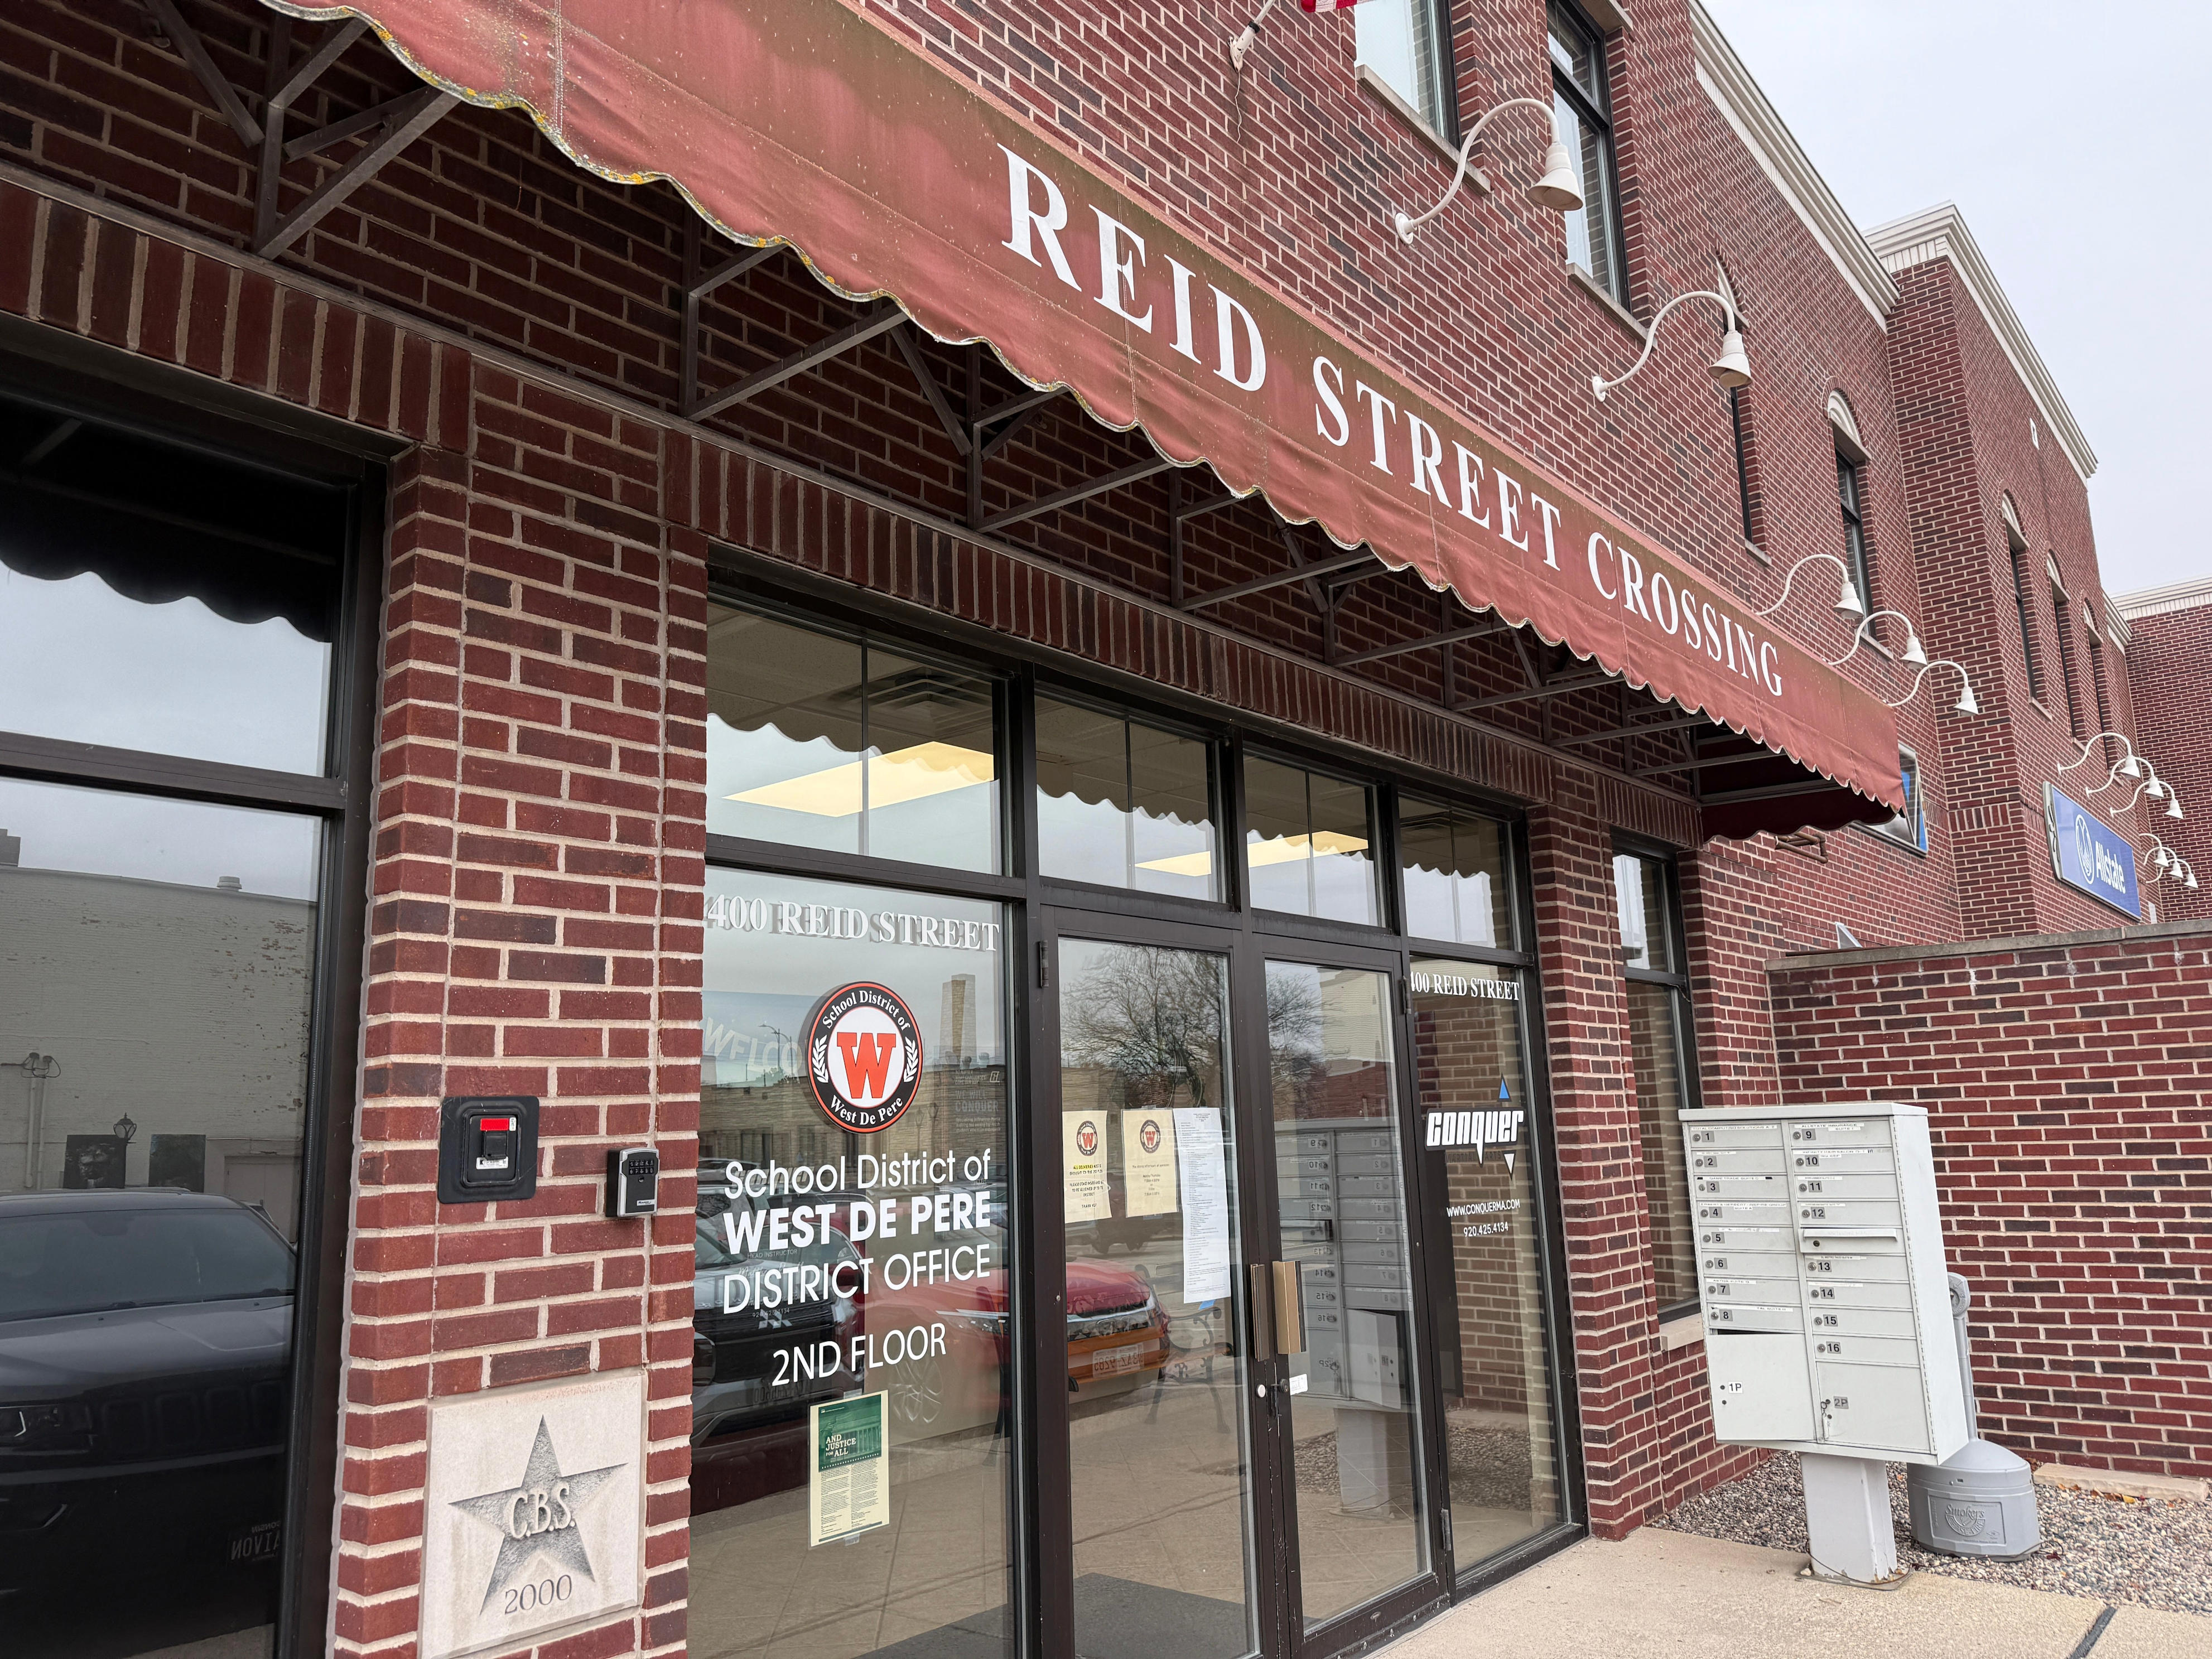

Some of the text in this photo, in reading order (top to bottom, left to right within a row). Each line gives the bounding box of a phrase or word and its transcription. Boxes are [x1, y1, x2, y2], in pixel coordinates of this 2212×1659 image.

[996, 142, 1782, 697] REID STREET CROSSING
[2095, 840, 2126, 894] Allstate
[707, 894, 999, 951] 400 REID STREET
[1433, 974, 1467, 996] REID
[1471, 977, 1519, 1001] STREET
[822, 990, 910, 1031] School District of
[837, 1032, 896, 1098] W
[831, 1094, 903, 1125] West De Pere
[1082, 1132, 1094, 1148] W
[1145, 1131, 1155, 1146] W
[724, 1155, 846, 1199] School
[857, 1150, 956, 1189] District
[964, 1148, 991, 1181] of
[1447, 1199, 1520, 1217] WWW.CONQUERMA.COM
[1812, 1209, 1824, 1217] 12
[723, 1191, 991, 1255] WEST DE PERE
[1464, 1222, 1509, 1237] 920.425.4134
[1819, 1262, 1830, 1271] 13
[724, 1244, 990, 1314] DISTRICT OFFICE
[1821, 1289, 1833, 1298] 14
[771, 1322, 947, 1387] 2ND FLOOR
[1827, 1343, 1840, 1352] 16
[1729, 1383, 1742, 1392] 1P
[1834, 1398, 1848, 1407] 2P
[826, 1434, 842, 1444] AND
[826, 1438, 856, 1451] JUSTICE
[834, 1448, 849, 1457] ALL
[510, 1480, 576, 1539] C.B.S.
[504, 1574, 572, 1615] 2000
